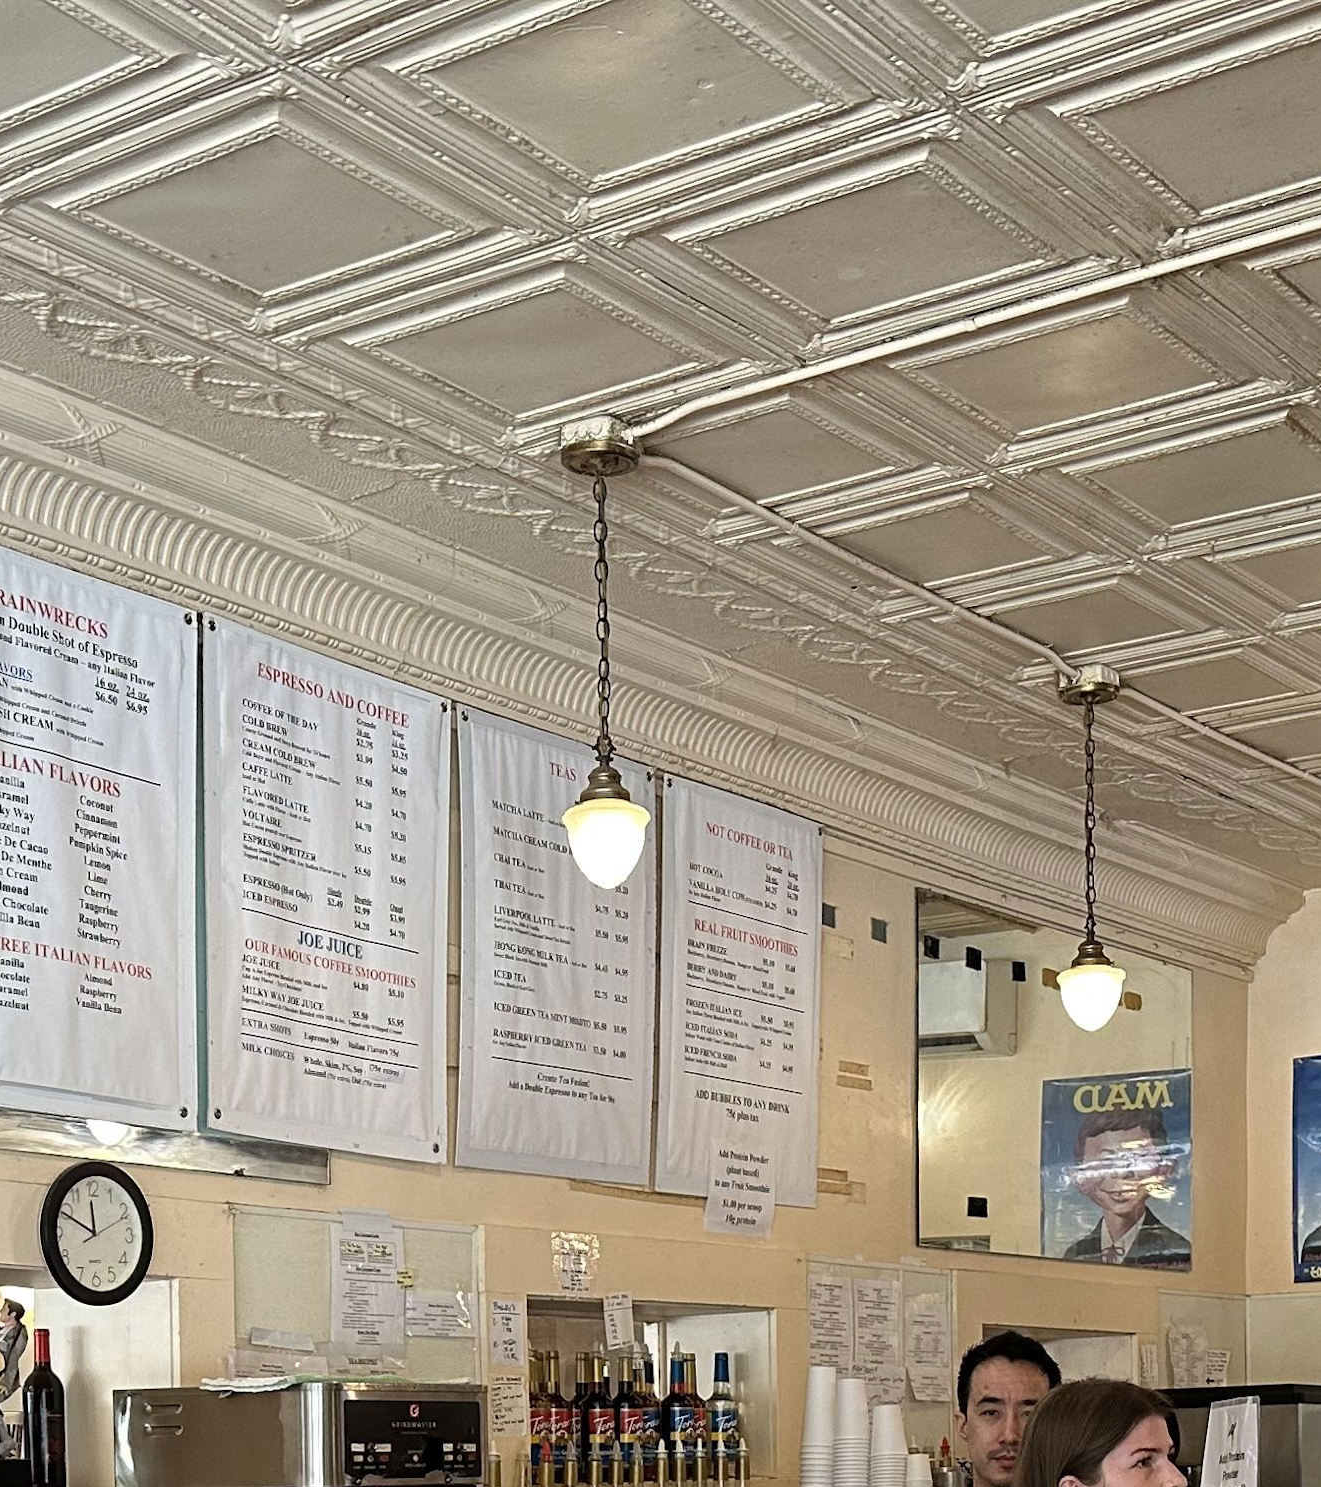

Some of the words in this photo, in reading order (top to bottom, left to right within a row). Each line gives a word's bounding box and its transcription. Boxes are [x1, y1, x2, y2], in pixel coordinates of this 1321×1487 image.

[8, 617, 49, 638] Double
[52, 629, 75, 649] Shot
[78, 641, 89, 653] of
[92, 644, 138, 668] Espresso
[96, 691, 118, 706] $6.50
[126, 701, 148, 715] $6.95
[258, 662, 324, 698] ESPRESSO
[327, 690, 354, 709] AND
[357, 700, 409, 728] COFFEE
[50, 765, 120, 797] FLAVORS
[550, 762, 576, 781] TEAS
[79, 795, 113, 813] Coconut
[706, 822, 725, 840] NOT
[727, 829, 761, 851] COFFEE
[763, 840, 776, 854] OR
[778, 845, 793, 861] TEA
[298, 931, 323, 949] JOE
[326, 940, 363, 958] JUICE
[694, 919, 718, 938] REAL
[720, 926, 749, 945] FRUIT
[749, 933, 798, 957] SMOOTHIES
[34, 944, 90, 966] ITALIAN
[94, 956, 152, 980] FLAVORS
[245, 938, 270, 953] OUR
[272, 944, 312, 965] FAMOUS
[314, 955, 353, 975] COFFEE
[355, 965, 416, 988] SMOOTHIES
